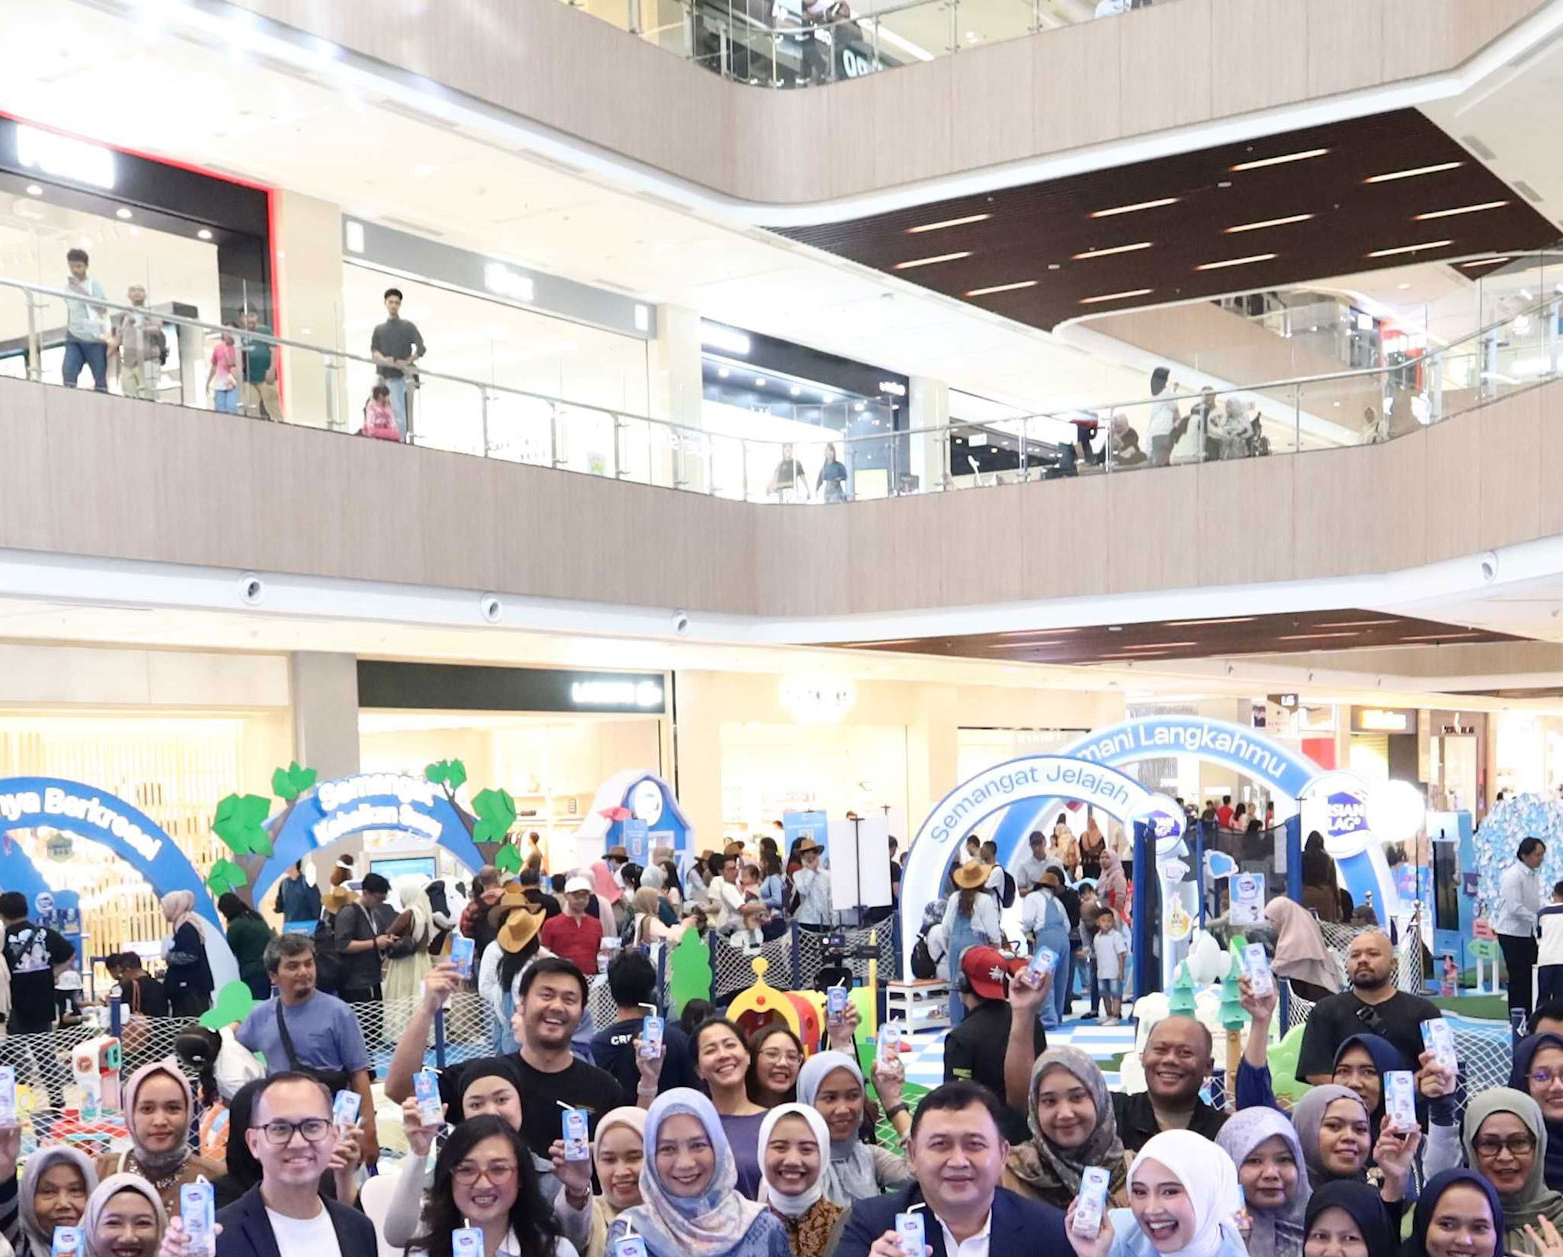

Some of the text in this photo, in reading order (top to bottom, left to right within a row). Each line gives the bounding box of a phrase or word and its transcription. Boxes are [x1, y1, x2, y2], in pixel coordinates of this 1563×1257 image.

[1076, 724, 1288, 779] mani Langkahmu
[930, 764, 1129, 844] Semangat Jelajah
